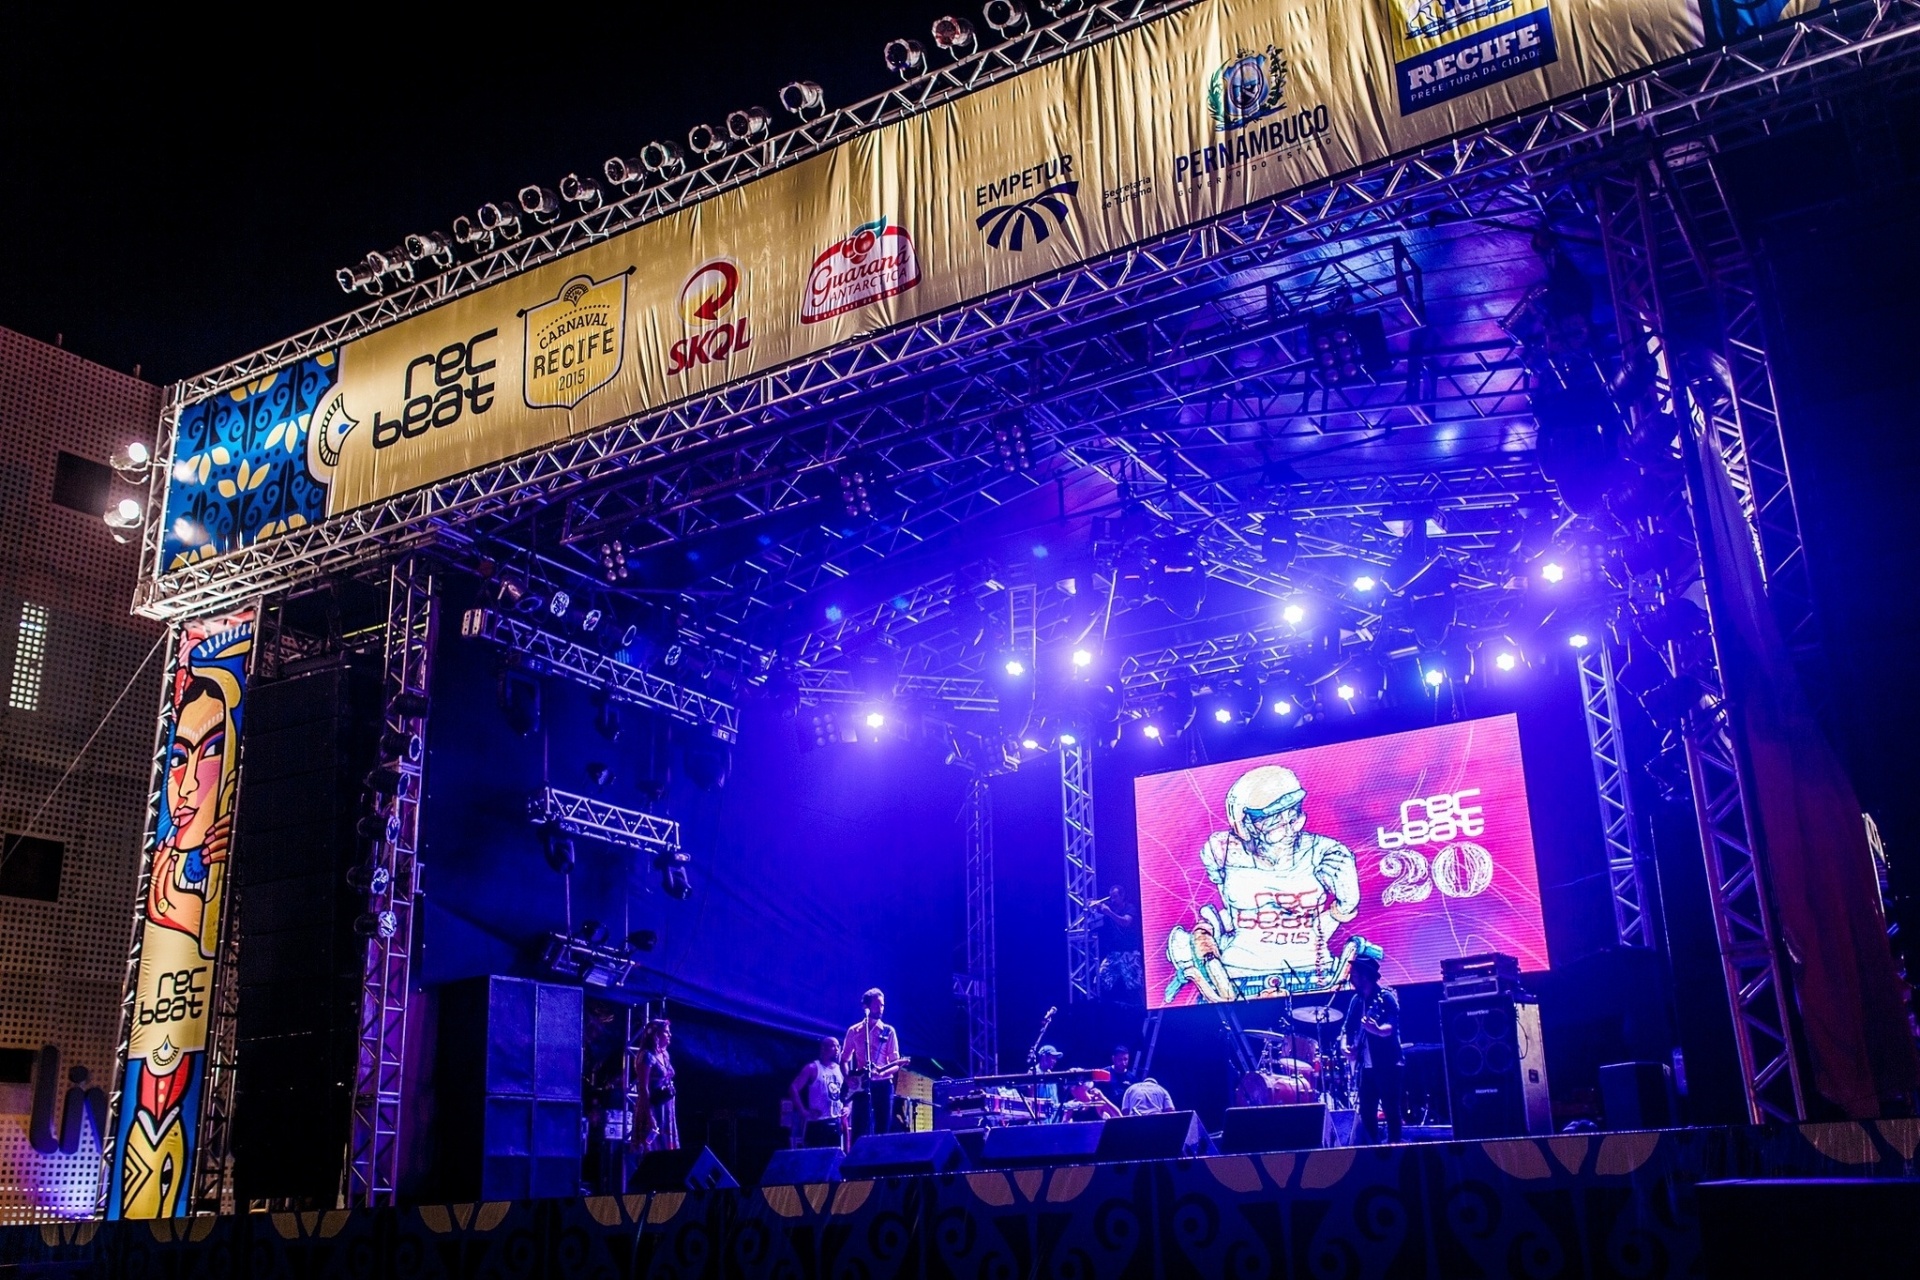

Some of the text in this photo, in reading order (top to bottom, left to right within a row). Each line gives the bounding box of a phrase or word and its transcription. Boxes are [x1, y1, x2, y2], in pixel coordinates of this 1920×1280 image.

[1408, 23, 1541, 91] RECIFE
[1411, 48, 1543, 102] PREFEITURA DA CIDADE
[1175, 104, 1330, 183] PERNAMBUCO
[1177, 137, 1332, 197] GOVERNO DO ESTADO
[976, 154, 1073, 207] EMPETUR
[1103, 177, 1152, 199] Secretaria
[1114, 187, 1152, 205] Turismo
[811, 244, 911, 308] Guaraná
[830, 267, 907, 301] ANTARCTICA
[533, 327, 615, 380] RECIFE
[539, 312, 608, 350] CARNAVAL
[666, 316, 753, 376] SKOL
[404, 327, 498, 401] rec
[558, 367, 586, 392] 2015
[372, 375, 495, 450] beat
[1377, 811, 1485, 849] beat
[1400, 787, 1481, 826] rec
[1379, 841, 1494, 907] 20
[1260, 930, 1310, 945] 2015
[157, 966, 207, 999] rec
[139, 994, 203, 1026] beat
